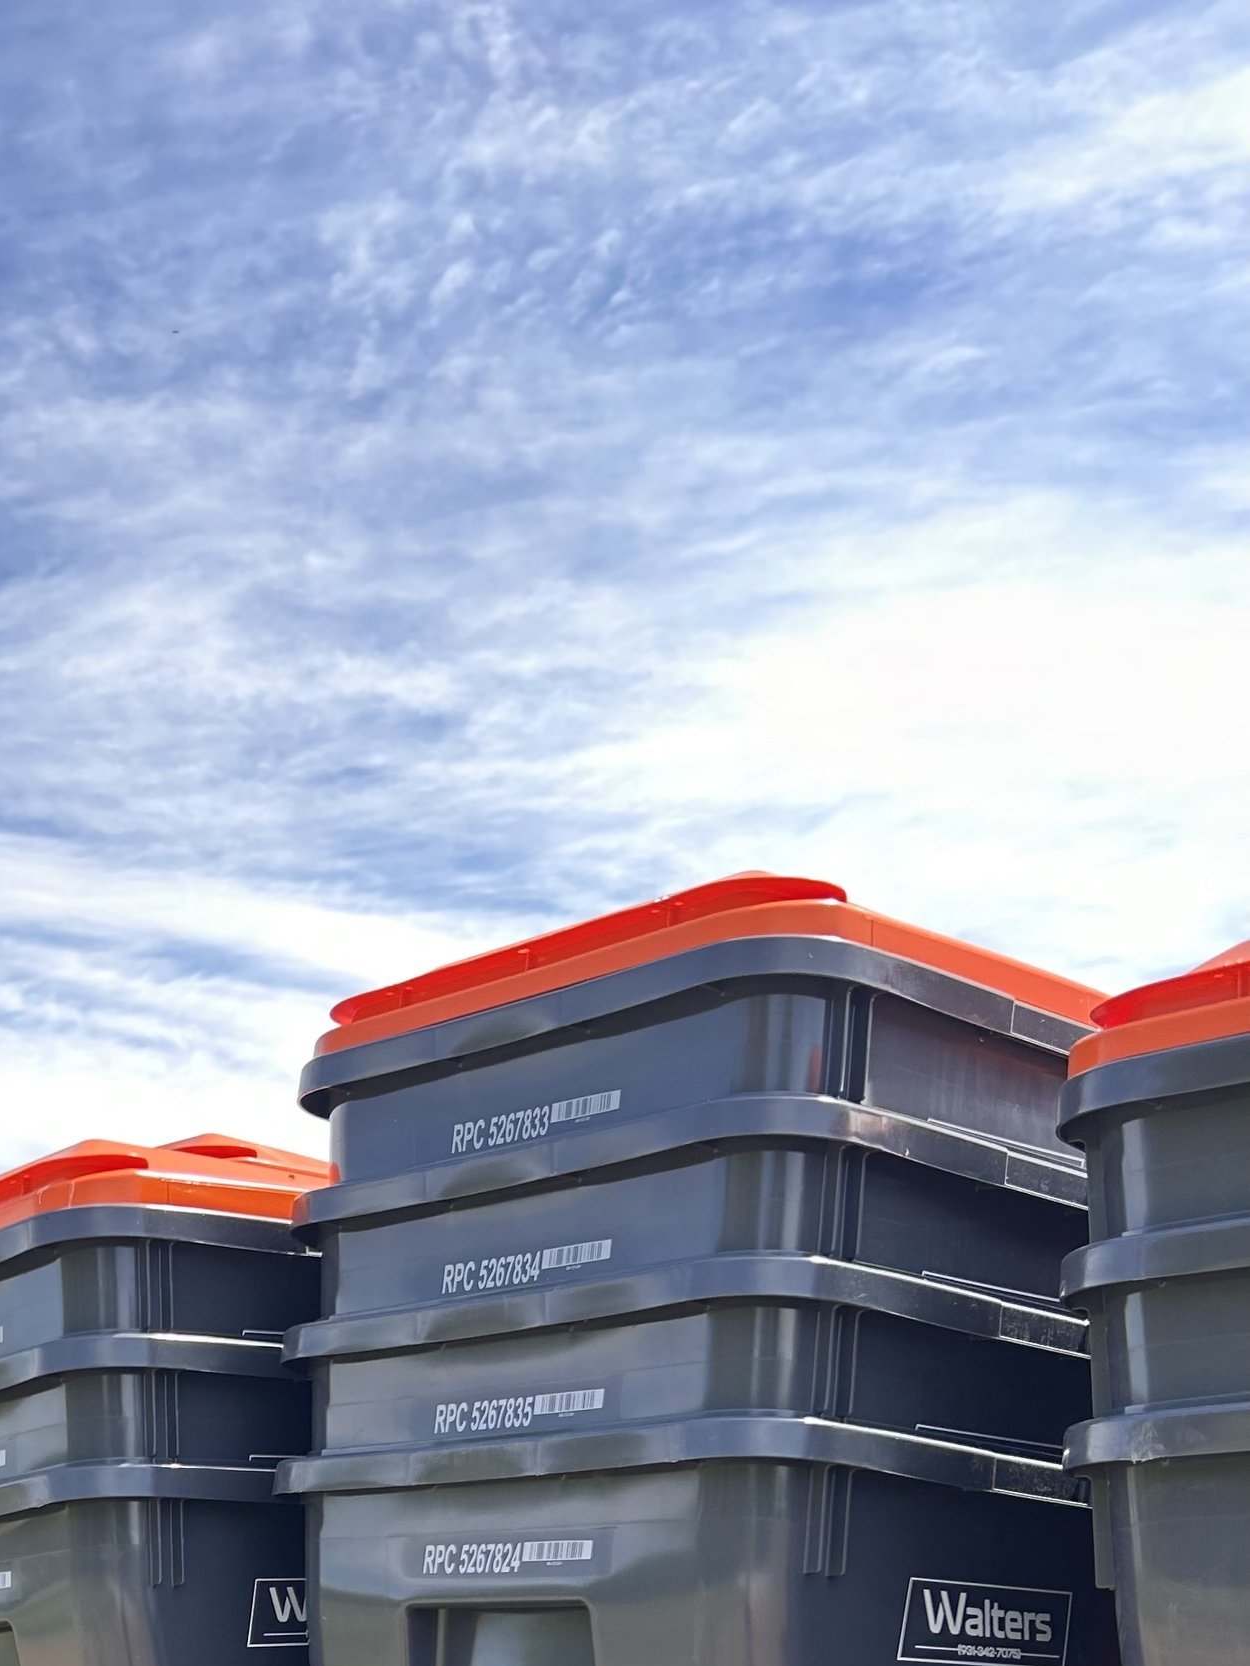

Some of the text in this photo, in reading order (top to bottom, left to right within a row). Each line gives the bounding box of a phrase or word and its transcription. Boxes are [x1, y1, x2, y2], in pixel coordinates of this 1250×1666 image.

[451, 1105, 550, 1154] RPC 5267833
[442, 1250, 541, 1295] RPC 5267834
[434, 1396, 534, 1434] RPC 5267835
[423, 1542, 522, 1575] RPC 5267824
[922, 1588, 1052, 1642] Walters
